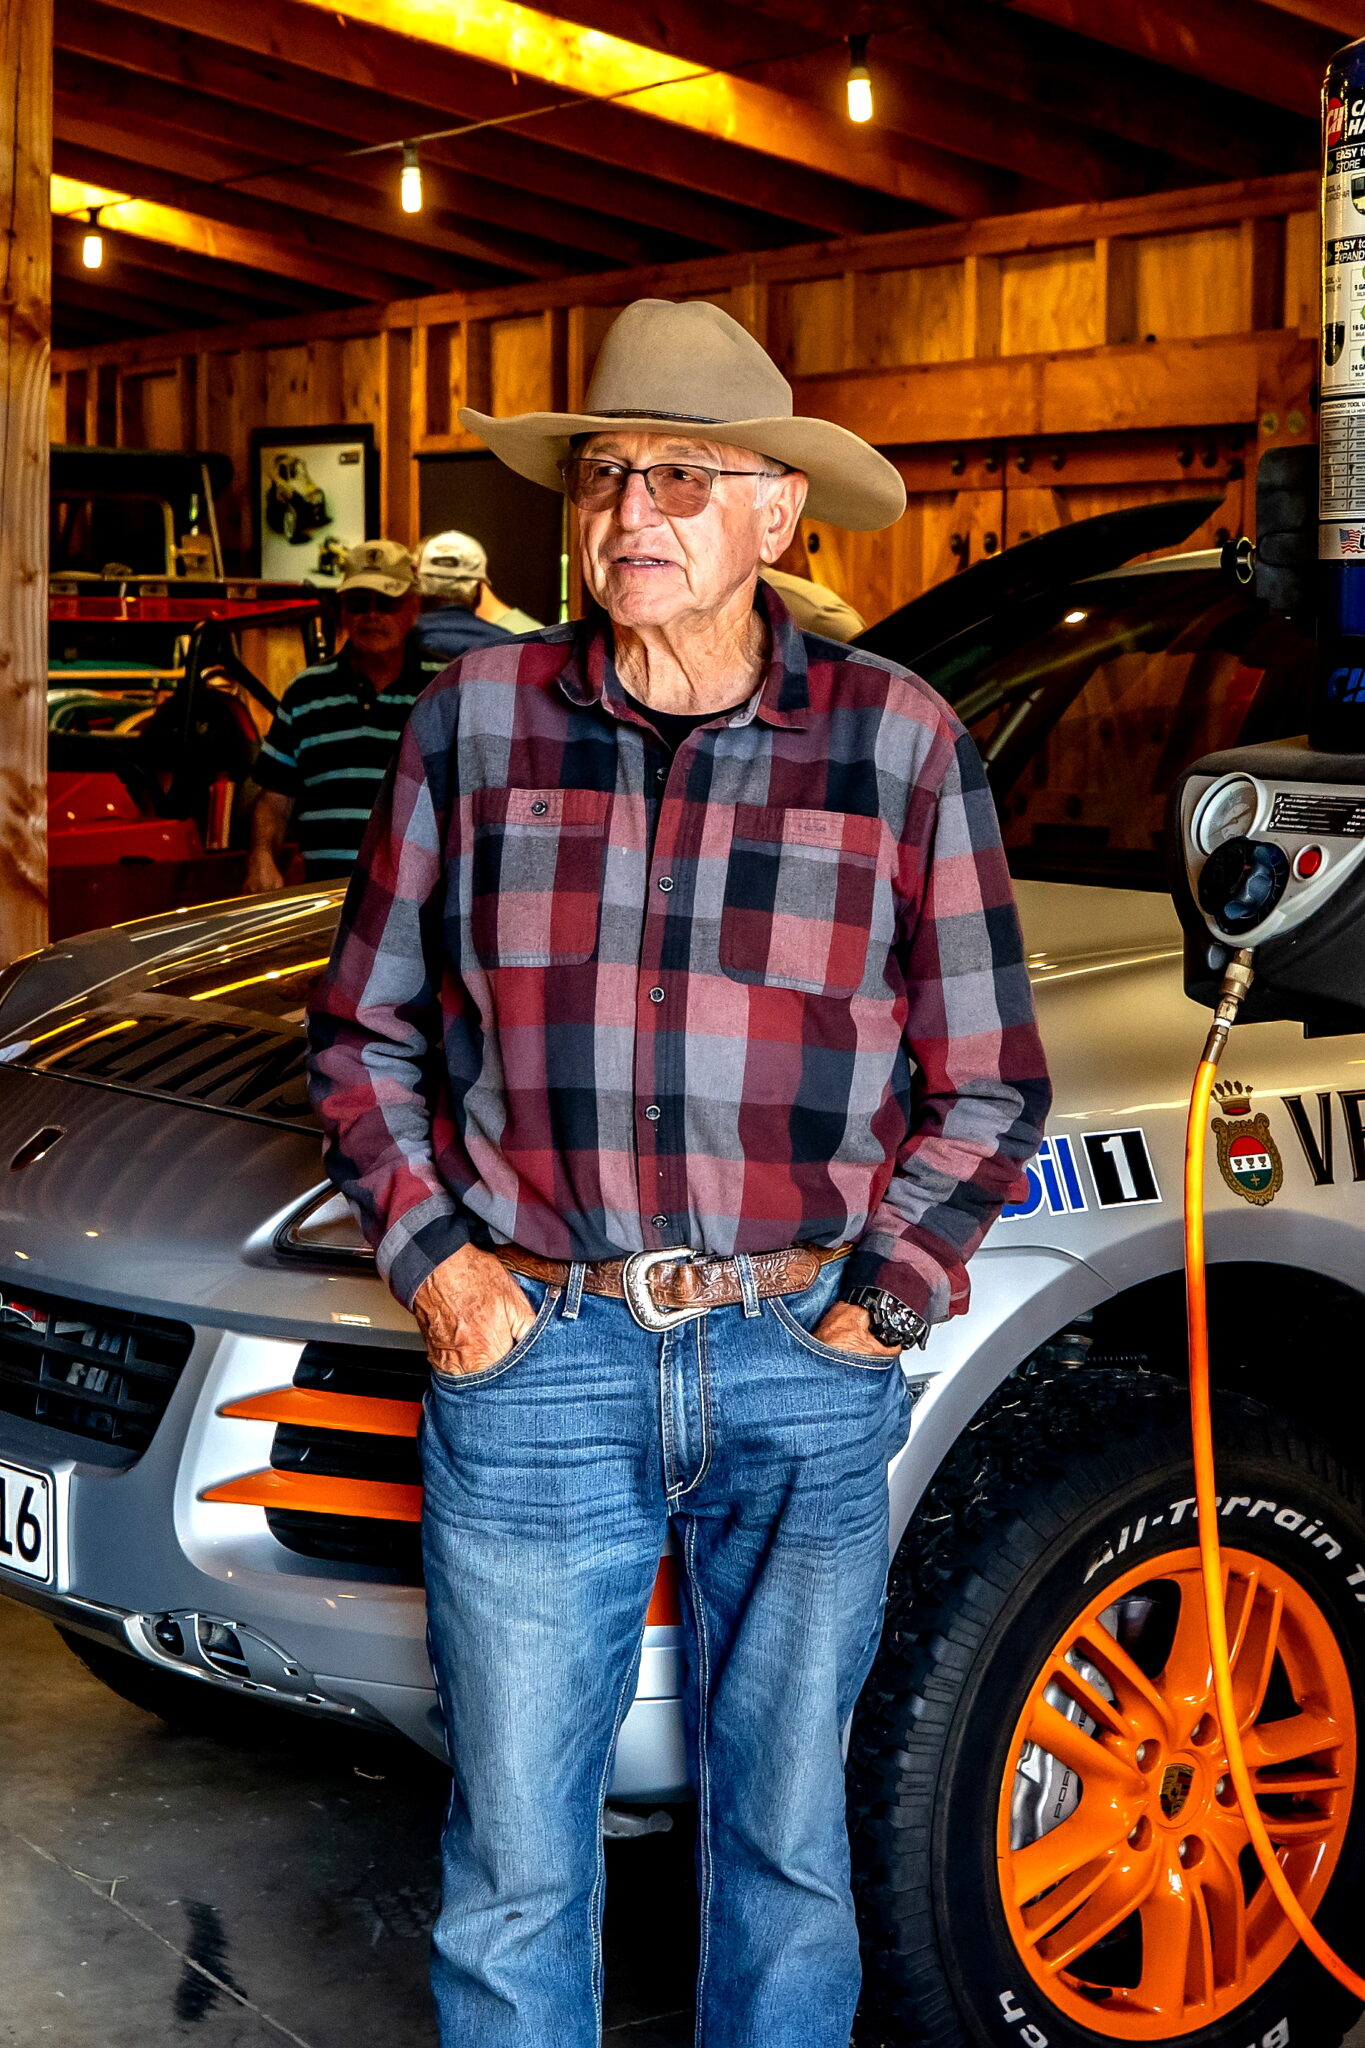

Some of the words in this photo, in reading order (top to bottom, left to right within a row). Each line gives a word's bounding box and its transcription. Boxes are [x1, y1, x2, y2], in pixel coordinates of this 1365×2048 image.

[1335, 147, 1358, 161] EASY
[1335, 159, 1361, 173] STORE
[1334, 239, 1356, 252] EASY
[1101, 1134, 1138, 1200] 1
[1083, 1495, 1343, 1585] All-Trrain
